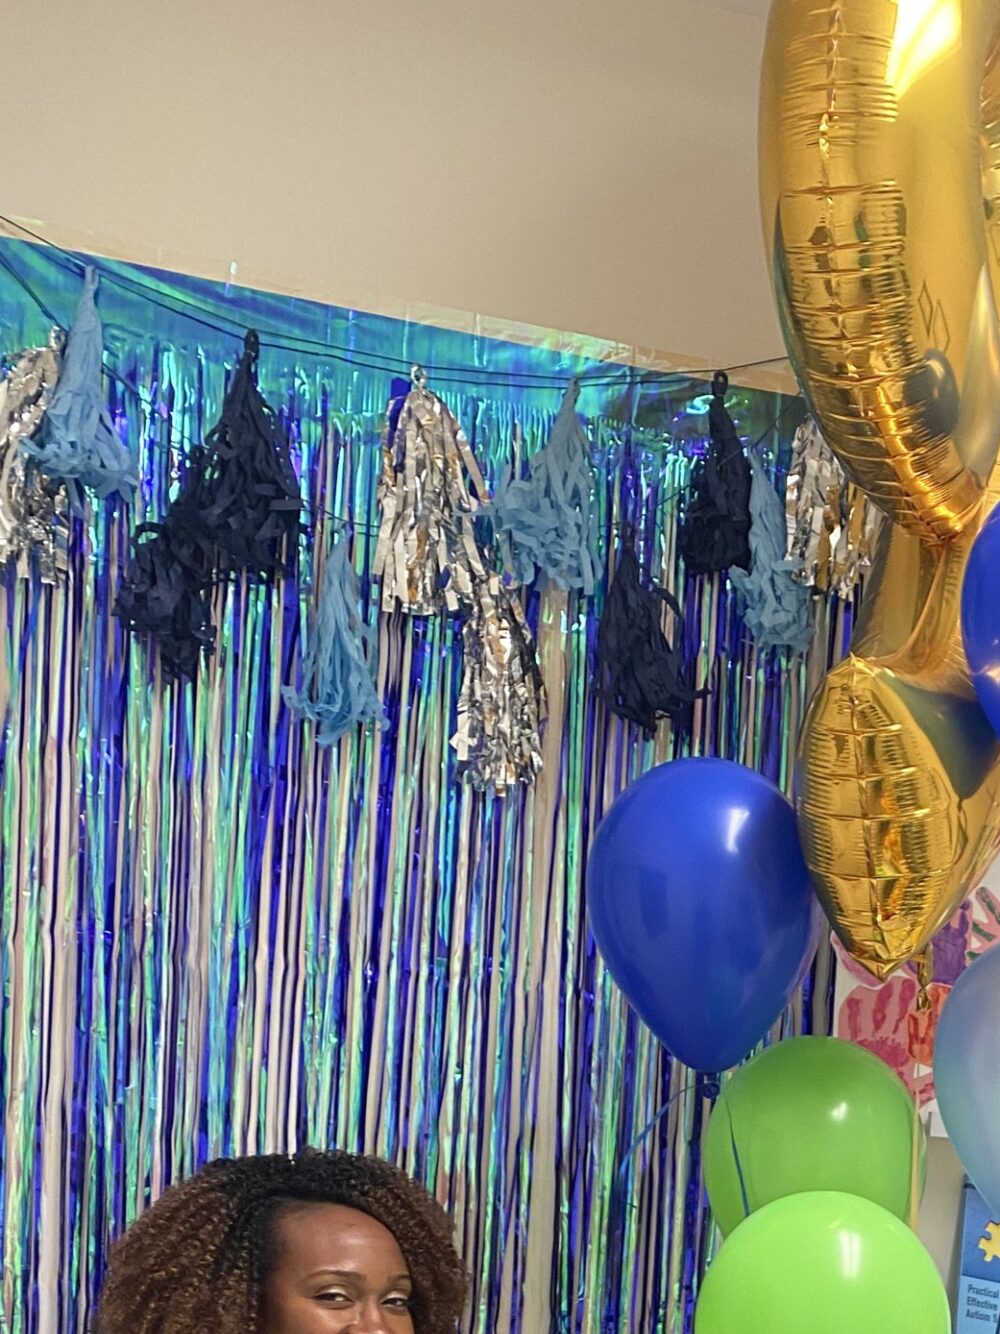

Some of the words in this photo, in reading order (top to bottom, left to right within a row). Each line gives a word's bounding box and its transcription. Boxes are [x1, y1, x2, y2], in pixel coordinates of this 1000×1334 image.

[967, 1283, 1000, 1298] Practical
[966, 1296, 998, 1311] Effective
[965, 1308, 991, 1322] Autism
